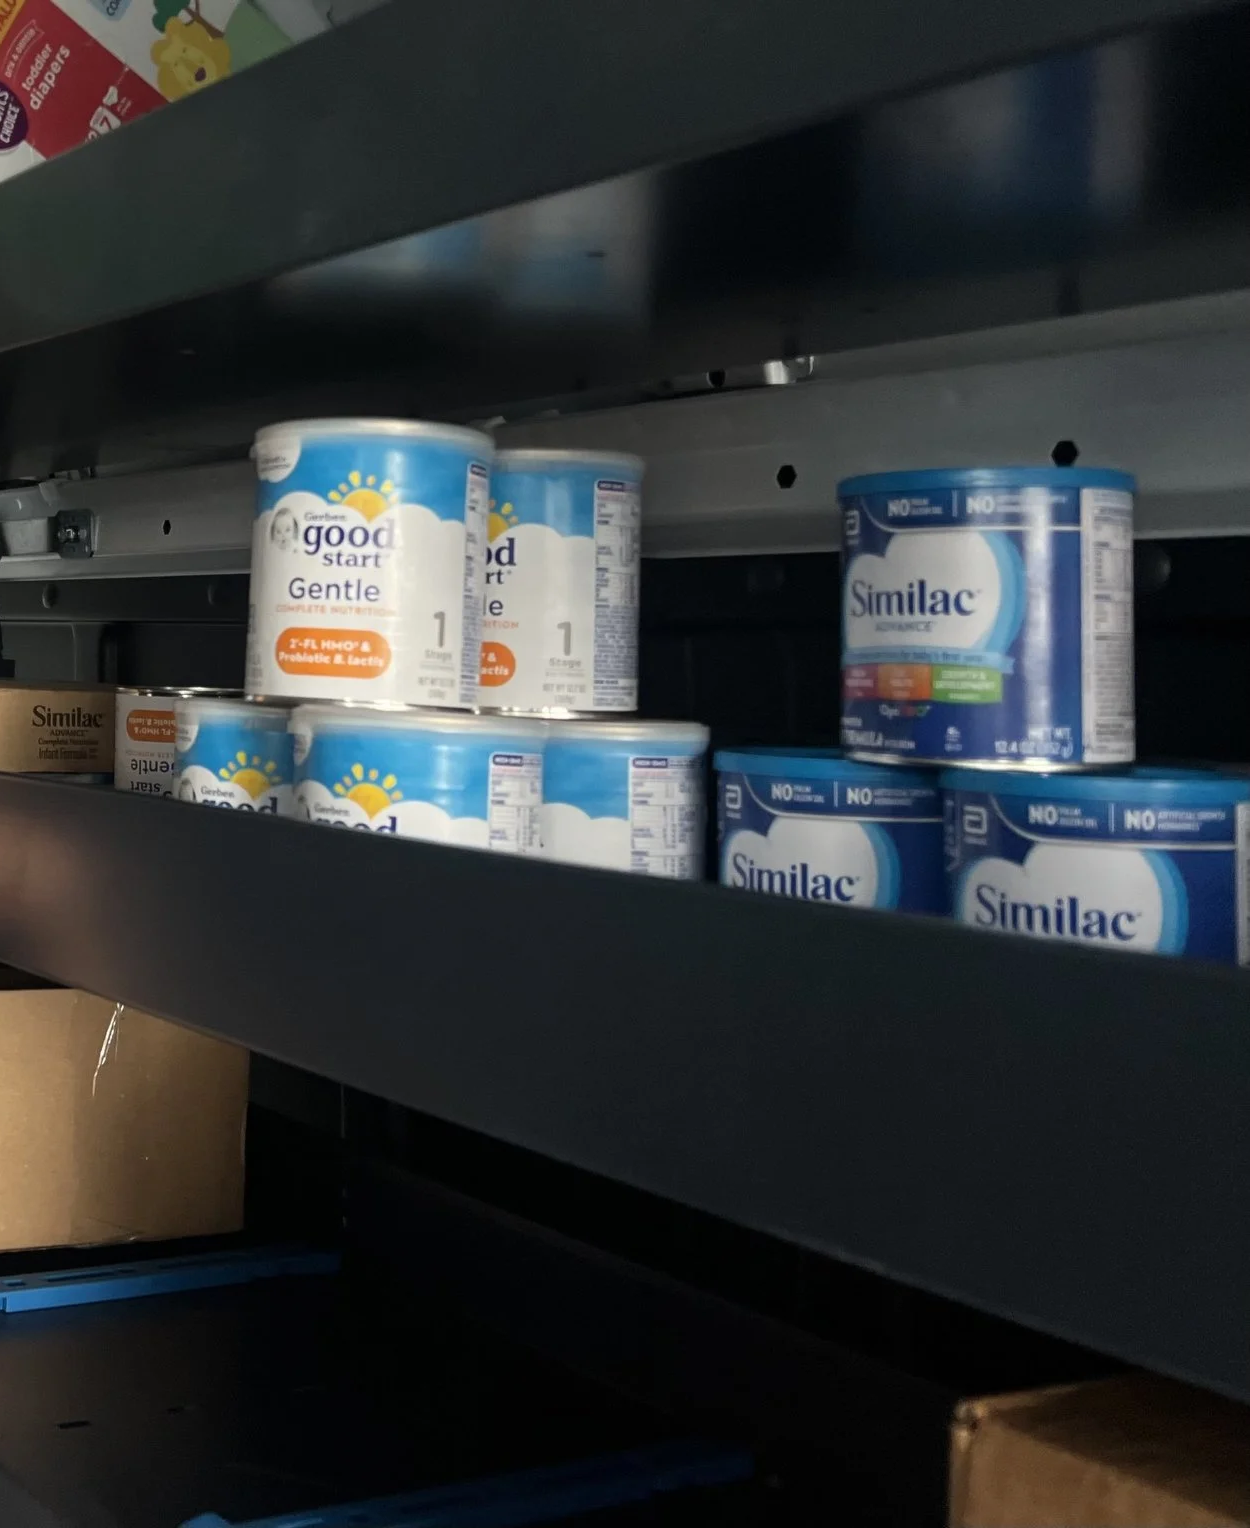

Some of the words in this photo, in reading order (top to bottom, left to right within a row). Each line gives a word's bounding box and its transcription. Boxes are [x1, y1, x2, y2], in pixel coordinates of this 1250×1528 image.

[22, 43, 52, 91] toddler
[29, 45, 70, 110] diapers
[0, 103, 21, 144] CHOICE
[888, 499, 910, 517] NO
[966, 496, 996, 514] NO
[303, 518, 395, 556] good
[322, 550, 381, 568] start
[288, 577, 380, 602] Gentle
[851, 578, 976, 617] Similac
[434, 611, 446, 648] 1
[557, 621, 571, 656] 1
[279, 652, 330, 664] Probiotic
[360, 640, 371, 653] &
[487, 652, 497, 662] &
[481, 664, 510, 676] actis
[32, 704, 103, 727] Similac
[130, 759, 174, 776] entle
[771, 783, 793, 801] NO
[846, 787, 872, 806] NO
[1028, 805, 1058, 825] NO
[1124, 808, 1155, 831] NO
[733, 853, 855, 902] Similac
[975, 884, 1137, 941] Similac
